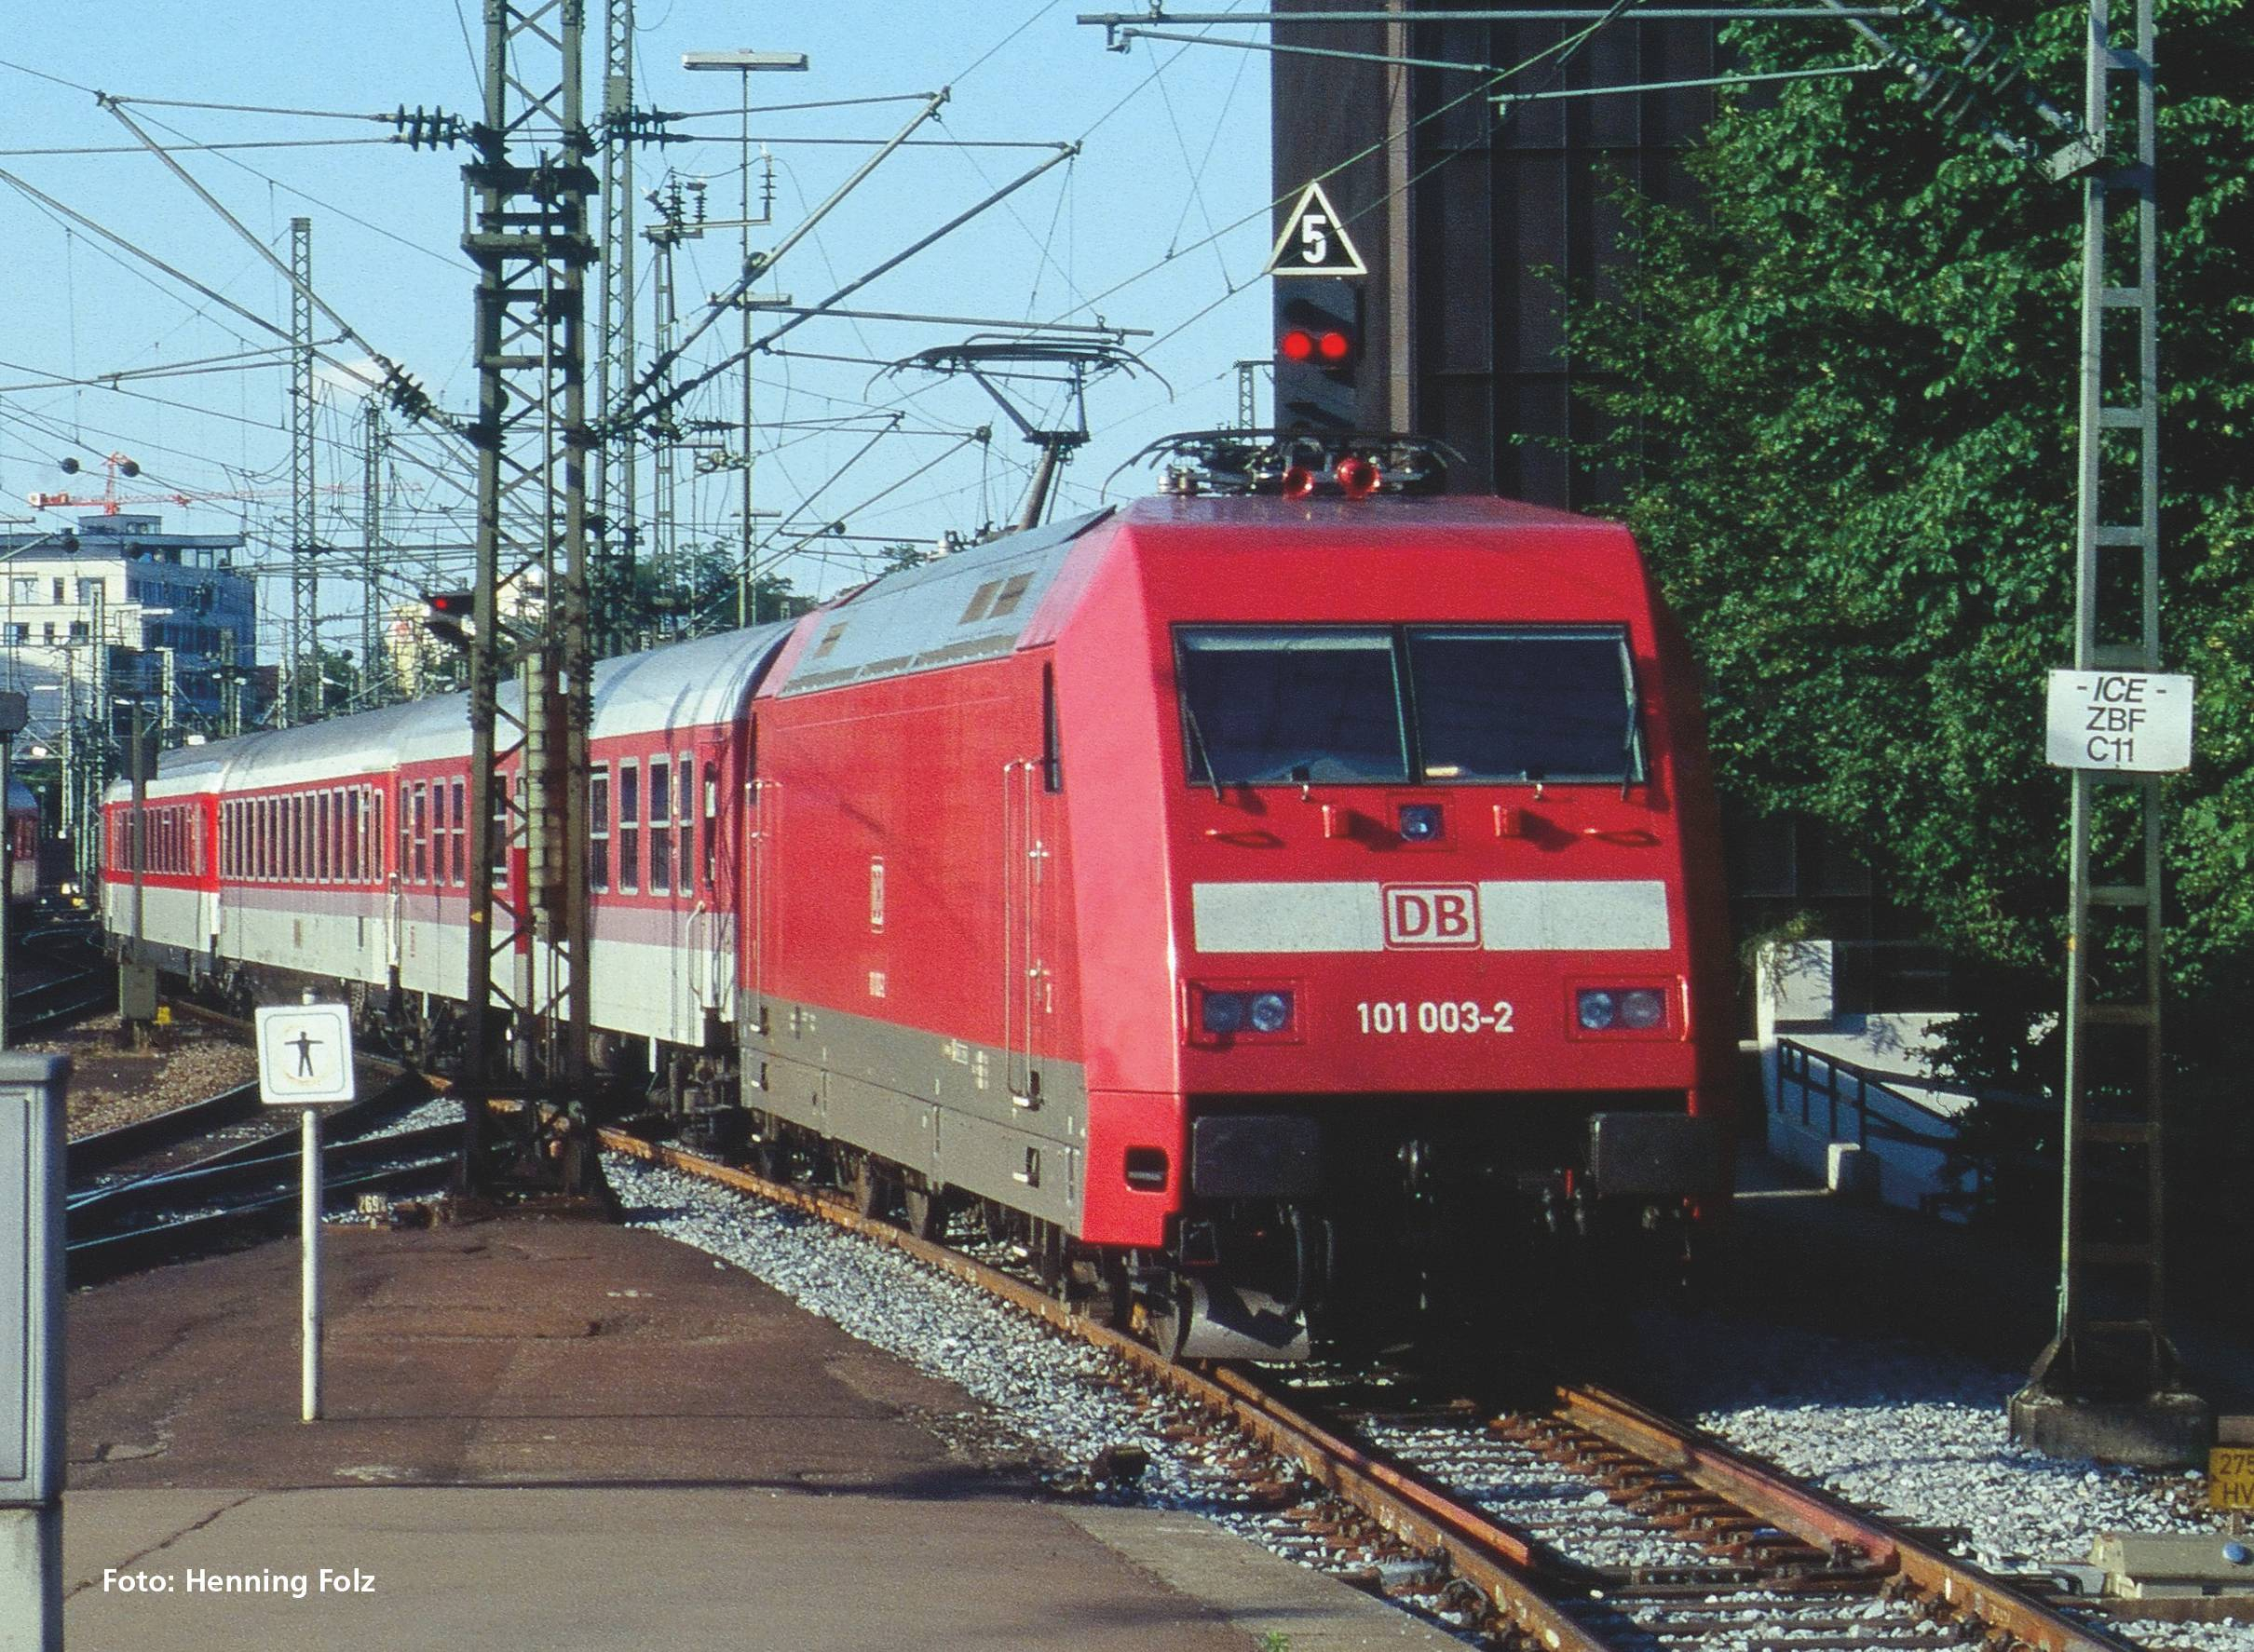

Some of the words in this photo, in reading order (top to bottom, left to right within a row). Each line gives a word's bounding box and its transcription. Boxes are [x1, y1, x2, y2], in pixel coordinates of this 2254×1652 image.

[1302, 215, 1326, 264] 5
[2086, 707, 2146, 732] ZBF
[2087, 736, 2134, 762] C11
[1395, 895, 1469, 936] DB
[1357, 1002, 1407, 1034] 101
[1419, 1001, 1514, 1033] 003-2
